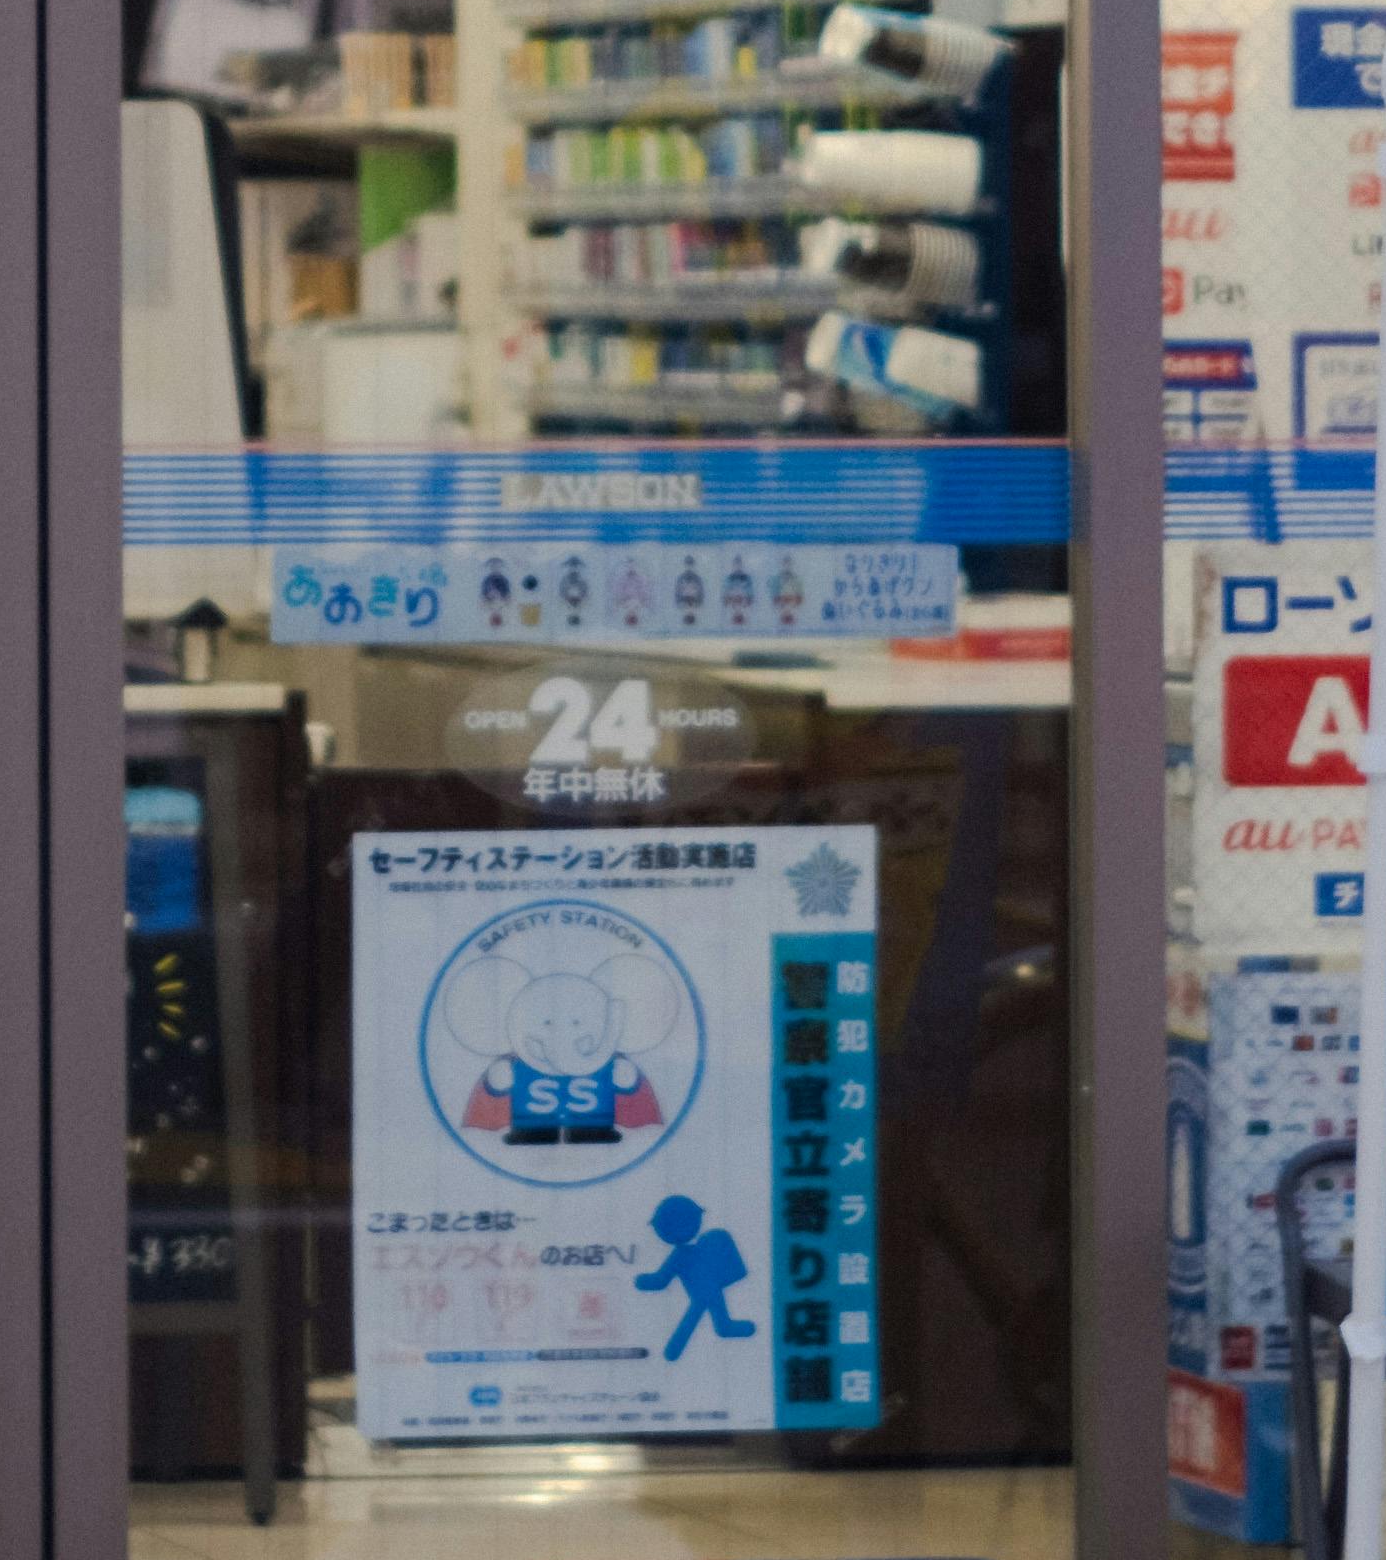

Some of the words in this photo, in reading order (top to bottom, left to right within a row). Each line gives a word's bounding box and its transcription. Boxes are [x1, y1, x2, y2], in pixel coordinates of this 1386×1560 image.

[465, 710, 527, 731] OPEN
[528, 677, 657, 765] 24
[659, 706, 737, 730] HOURS
[524, 766, 666, 803] 年中無休
[1223, 818, 1297, 852] au
[369, 841, 756, 874] セーフティステーション活動実施店
[477, 911, 551, 953] SAFETY
[560, 909, 644, 950] STATION
[526, 1078, 600, 1114] SS
[836, 960, 871, 1404] 防犯カメラ設置店
